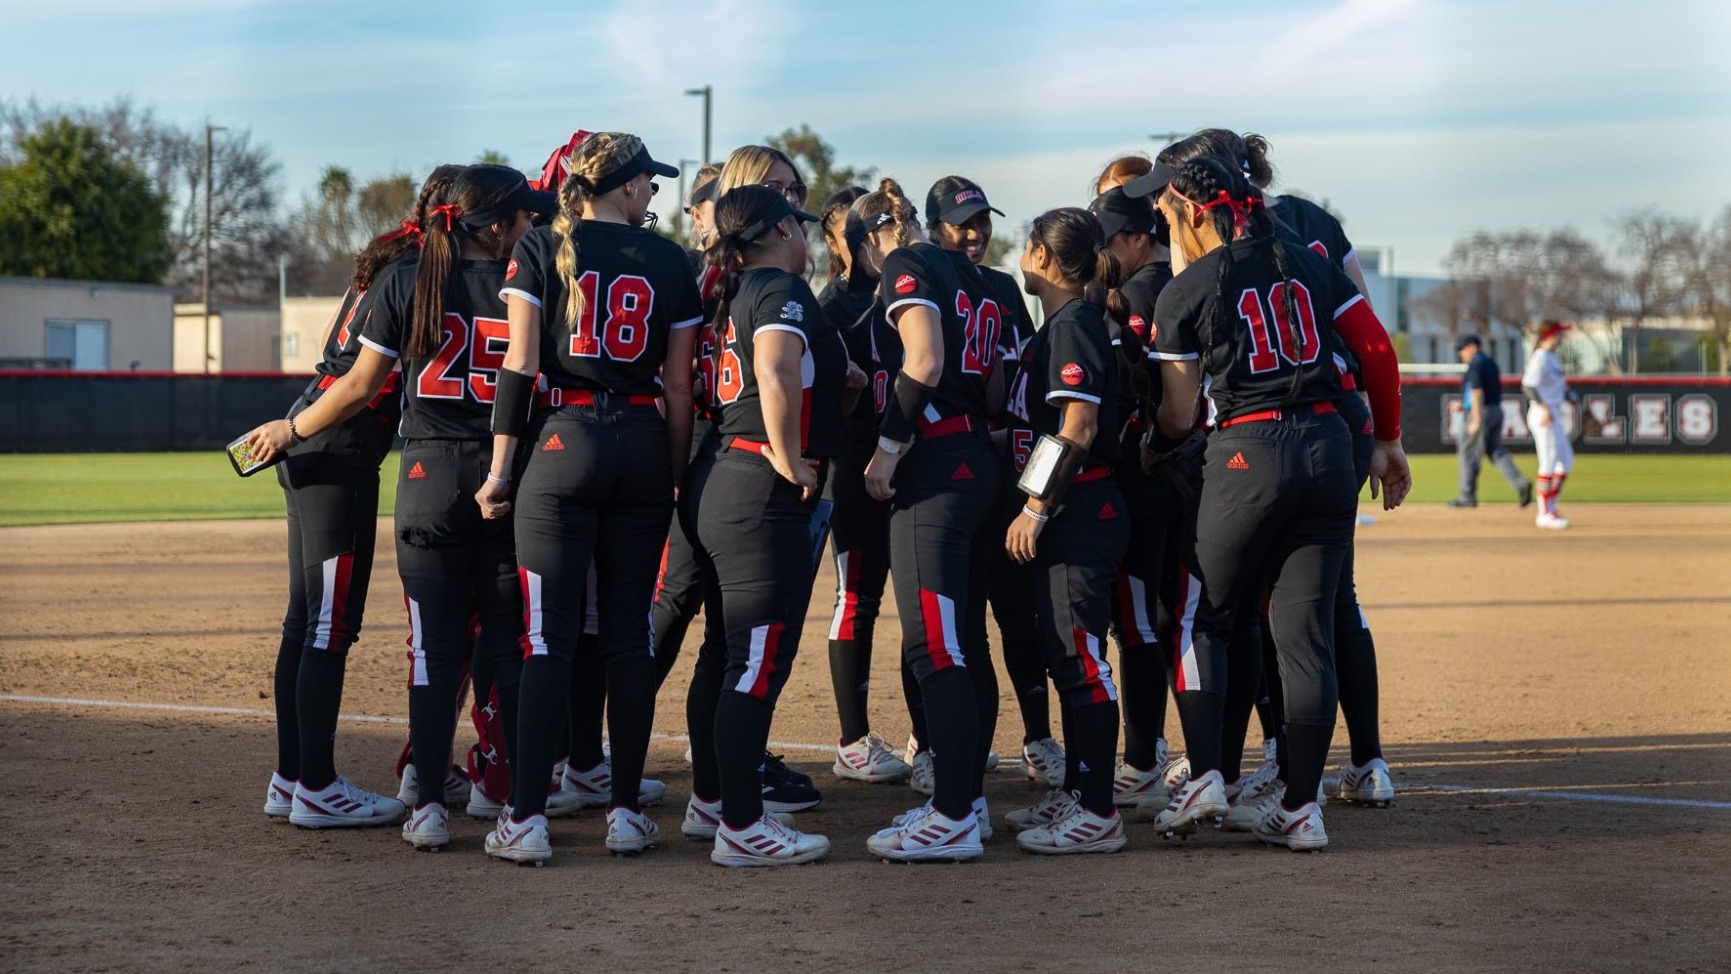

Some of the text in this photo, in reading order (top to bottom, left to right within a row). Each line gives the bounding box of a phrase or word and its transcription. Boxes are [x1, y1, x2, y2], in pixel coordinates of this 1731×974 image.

[417, 312, 511, 404] 25
[569, 270, 655, 362] 18
[955, 289, 1002, 381] 20
[1237, 279, 1321, 374] 10
[1441, 393, 1719, 447] ALES
